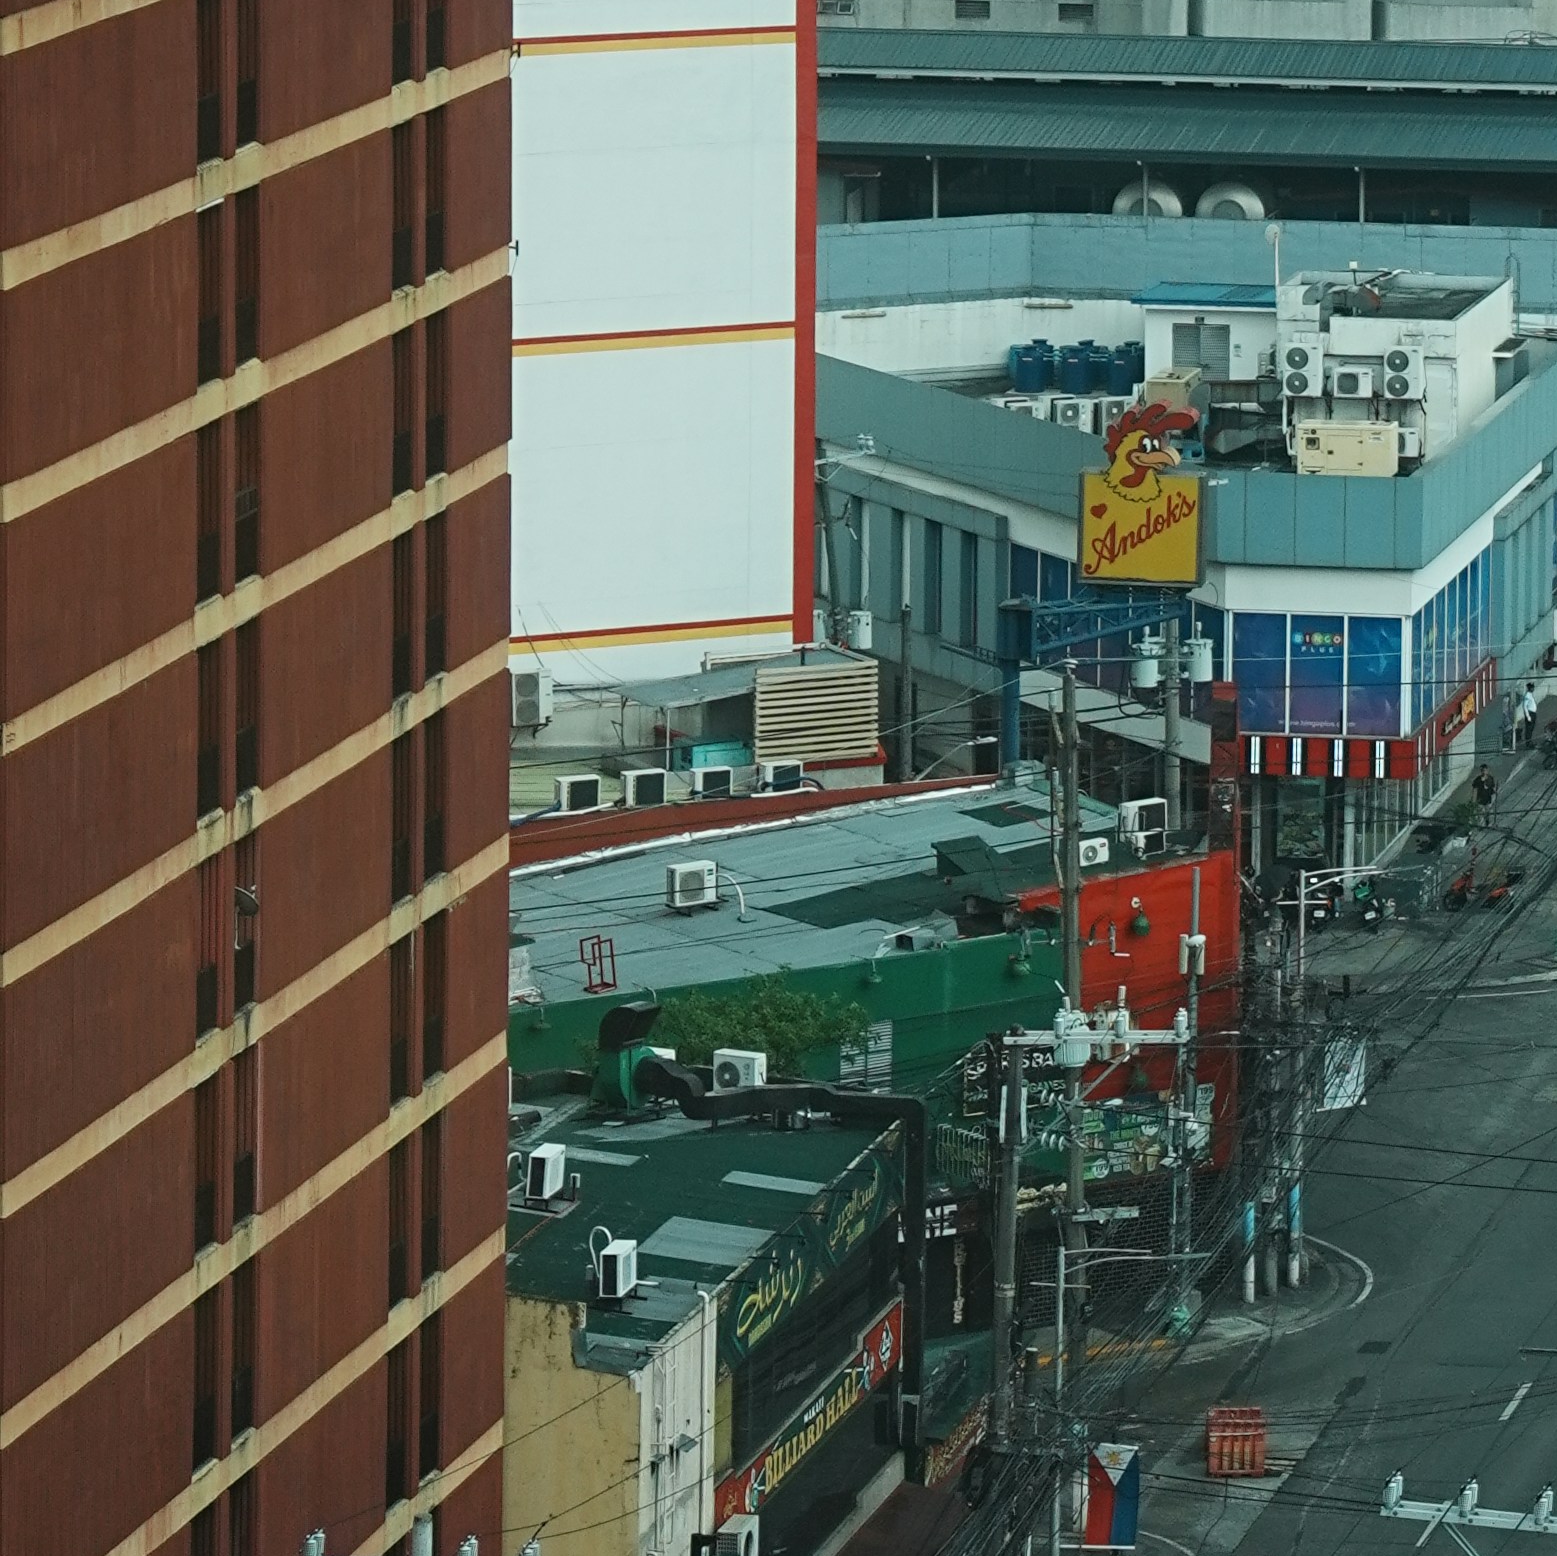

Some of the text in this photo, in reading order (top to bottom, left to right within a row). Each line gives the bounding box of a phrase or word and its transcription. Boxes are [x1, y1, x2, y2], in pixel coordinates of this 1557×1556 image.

[1084, 491, 1197, 575] Andok's
[1292, 632, 1342, 644] BINGO
[764, 1417, 824, 1494] BILLIARD
[825, 1368, 859, 1432] HALL
